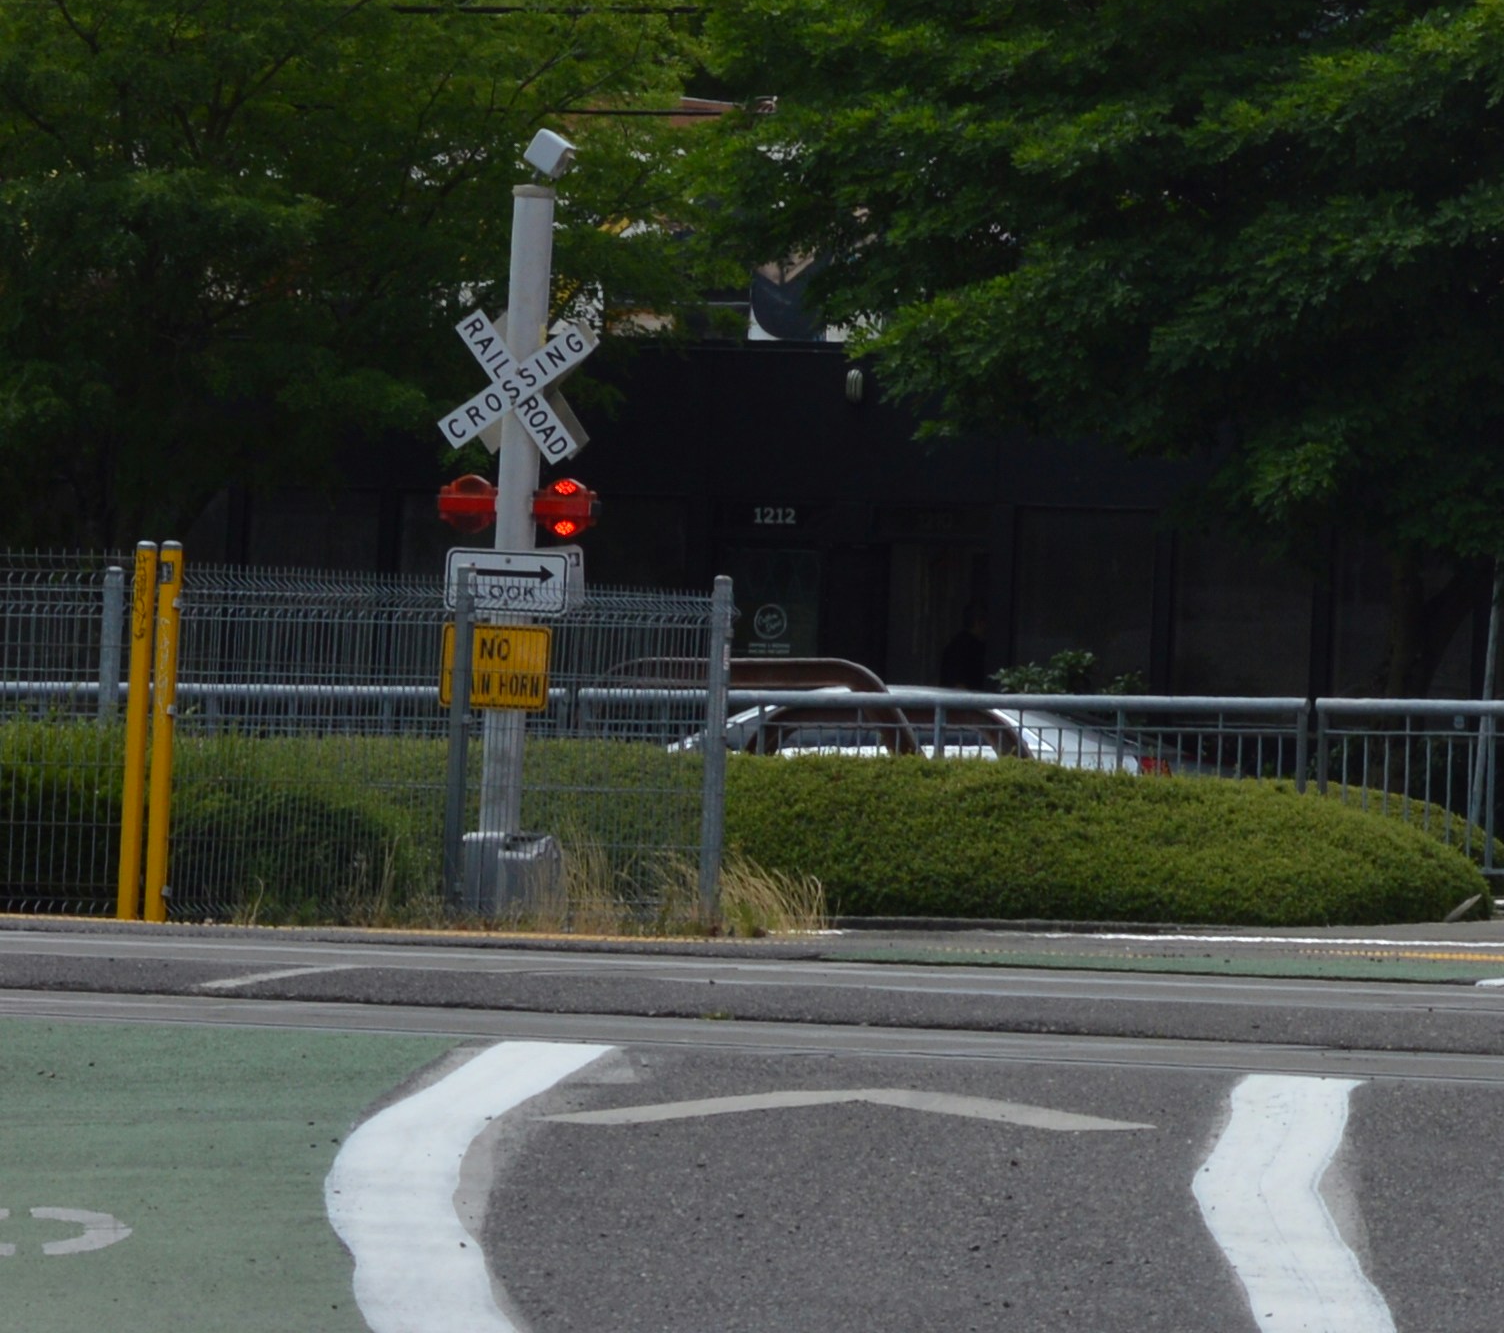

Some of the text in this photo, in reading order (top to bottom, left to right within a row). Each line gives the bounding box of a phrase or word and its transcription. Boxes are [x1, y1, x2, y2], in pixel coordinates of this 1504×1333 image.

[447, 333, 584, 439] CROSSING
[463, 317, 568, 456] RAIL ROAD
[753, 506, 797, 525] 1212
[475, 583, 536, 602] LOOK
[479, 637, 512, 662] NO
